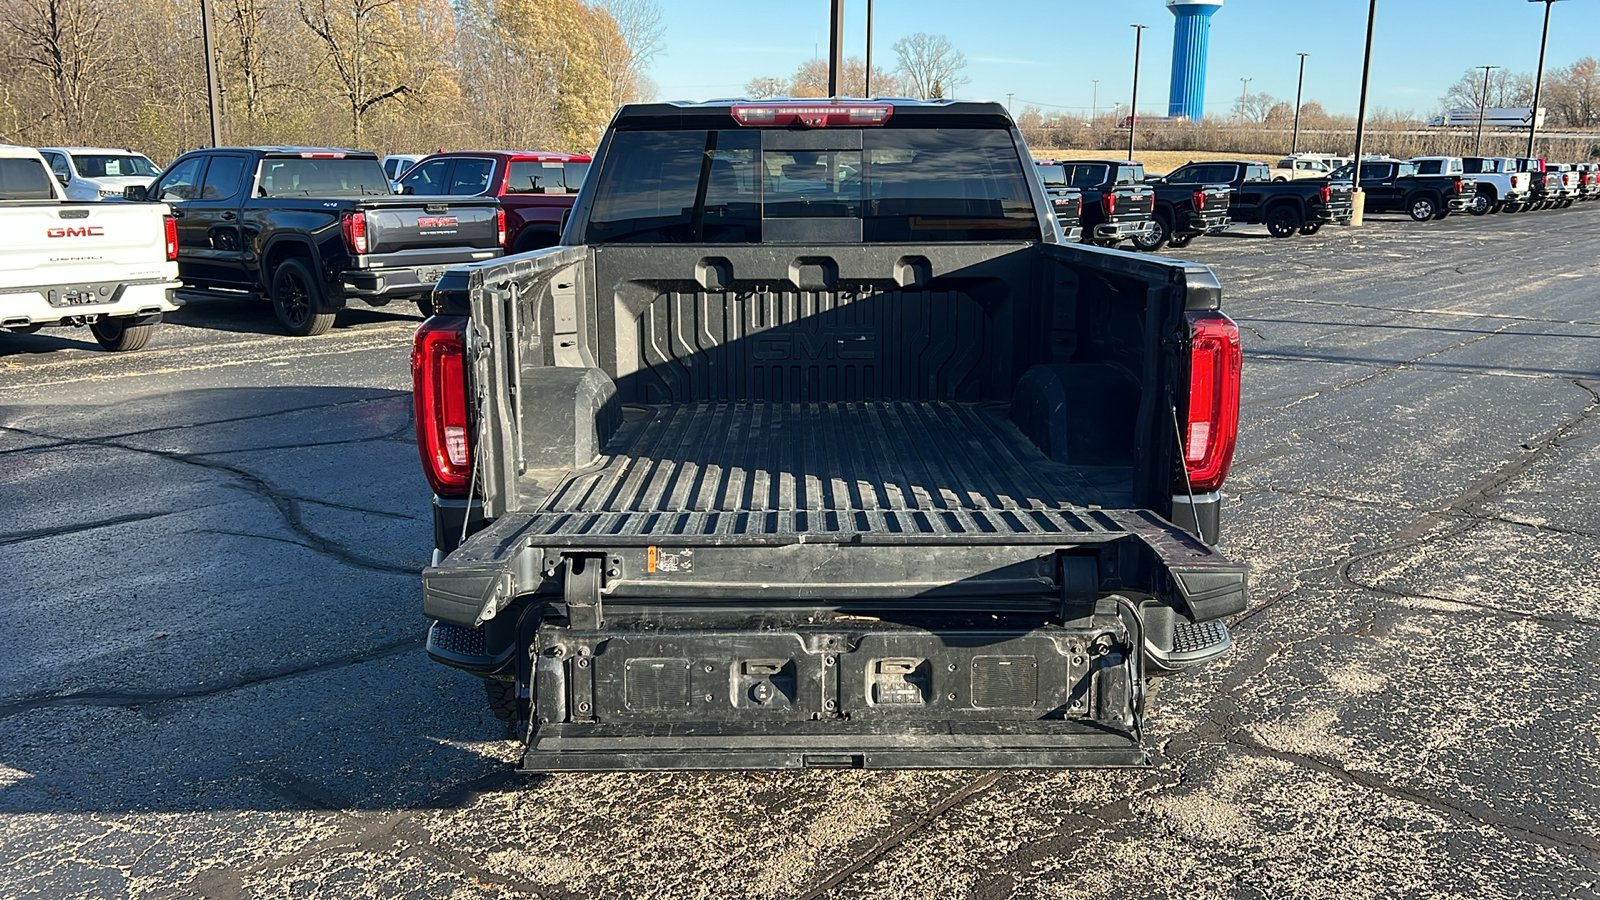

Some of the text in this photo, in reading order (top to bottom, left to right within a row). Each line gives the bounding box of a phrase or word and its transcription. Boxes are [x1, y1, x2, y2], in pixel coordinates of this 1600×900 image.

[417, 216, 459, 227] GMC
[47, 226, 104, 238] GMC
[752, 332, 875, 360] GMC
